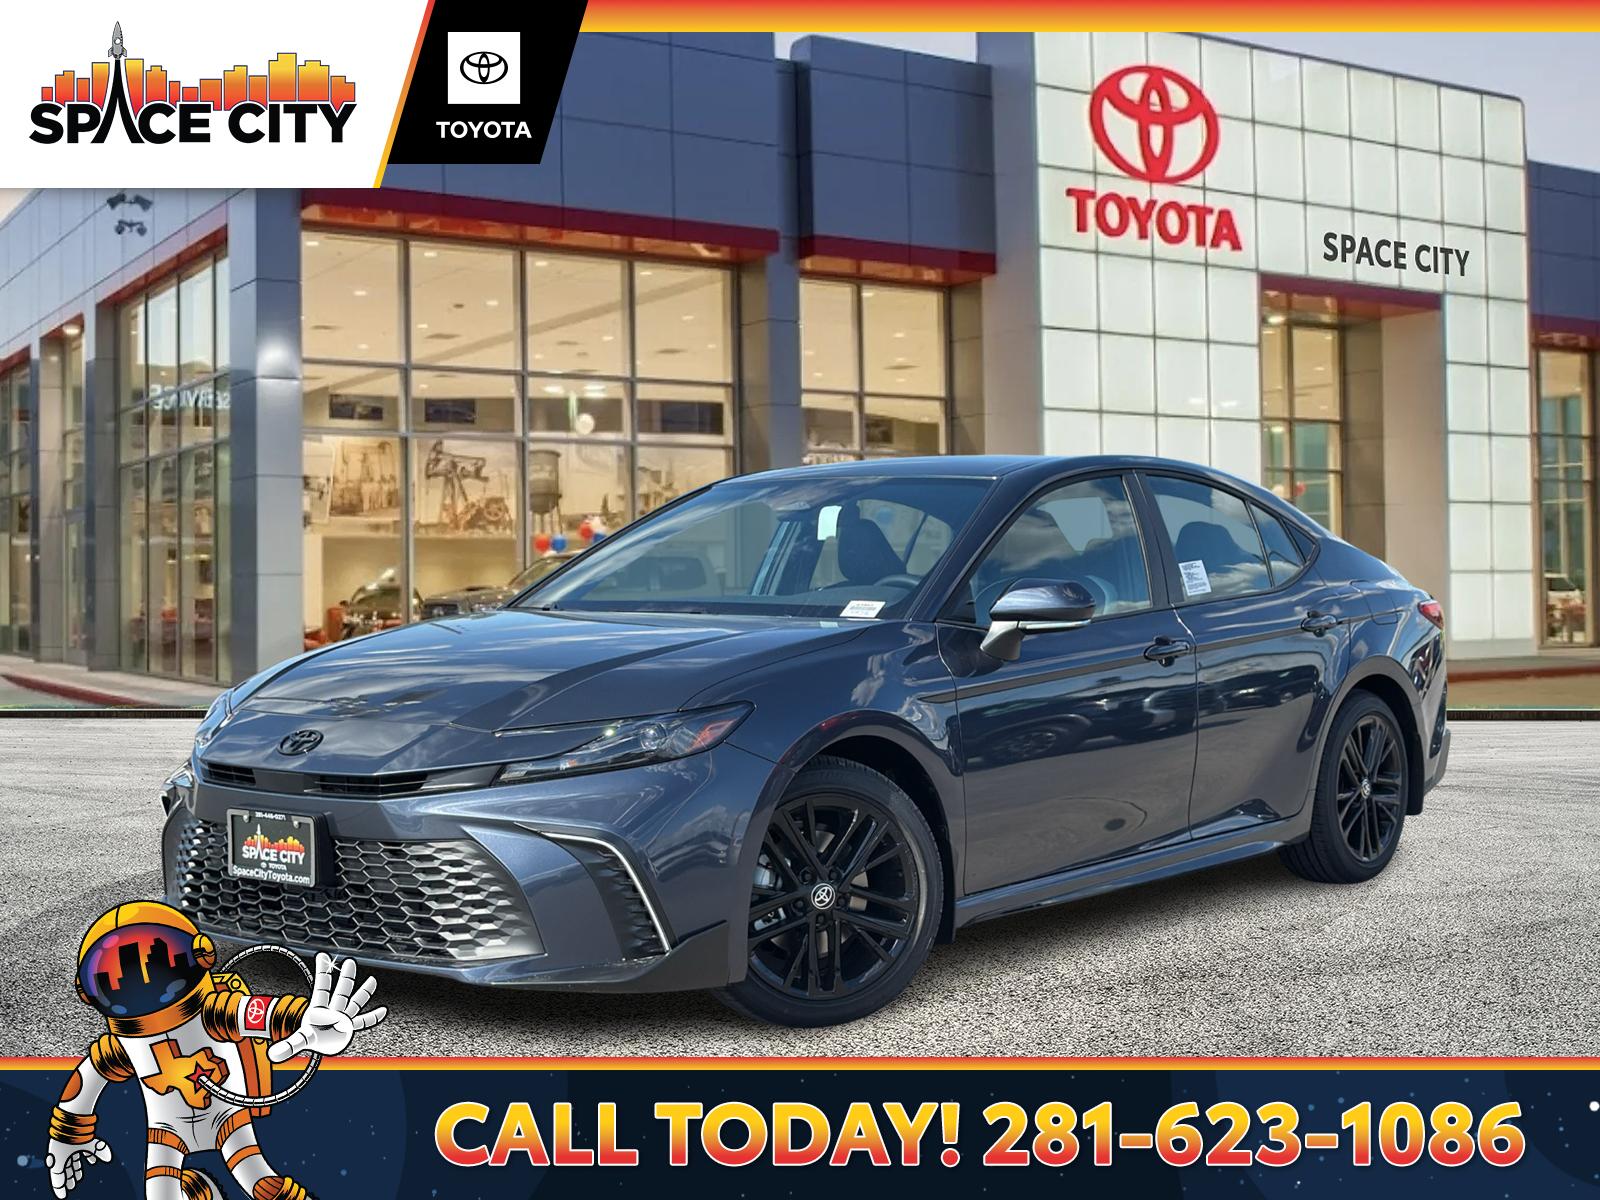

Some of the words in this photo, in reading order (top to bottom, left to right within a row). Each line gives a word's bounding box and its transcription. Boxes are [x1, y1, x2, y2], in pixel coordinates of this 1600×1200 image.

[1066, 188, 1242, 251] TOYOTA
[1323, 231, 1407, 270] SPACE
[1415, 244, 1470, 277] CITY
[242, 835, 278, 861] SPACE
[279, 851, 305, 864] CITY
[232, 865, 310, 884] SpaceCityToyota.com
[268, 862, 287, 870] TOYOTA
